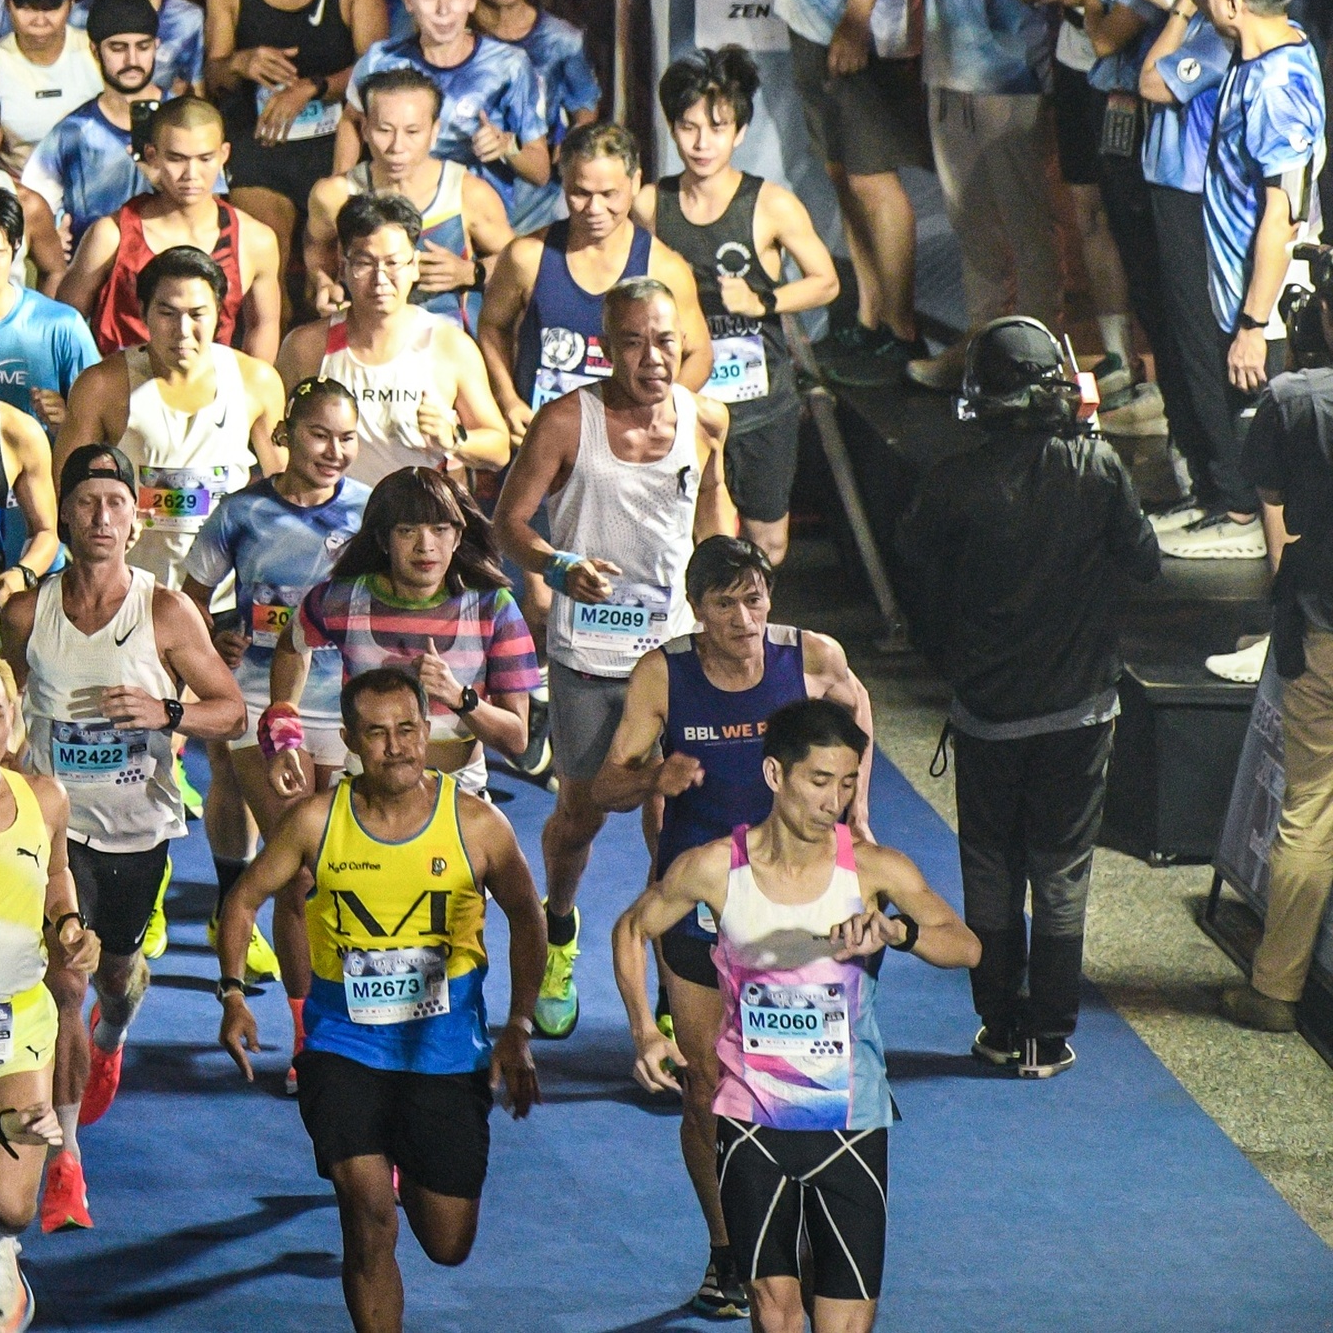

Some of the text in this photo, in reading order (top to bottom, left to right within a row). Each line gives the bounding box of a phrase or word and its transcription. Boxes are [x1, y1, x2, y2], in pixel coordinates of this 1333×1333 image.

[728, 3, 771, 19] ZEN
[353, 388, 418, 404] RMIN
[152, 493, 197, 510] 2629
[580, 605, 644, 628] M2089
[684, 726, 720, 741] BBL
[722, 725, 751, 739] WE
[59, 746, 123, 765] M2422
[349, 859, 382, 872] Coffee
[352, 978, 421, 999] M2673
[748, 1010, 818, 1031] M2060
